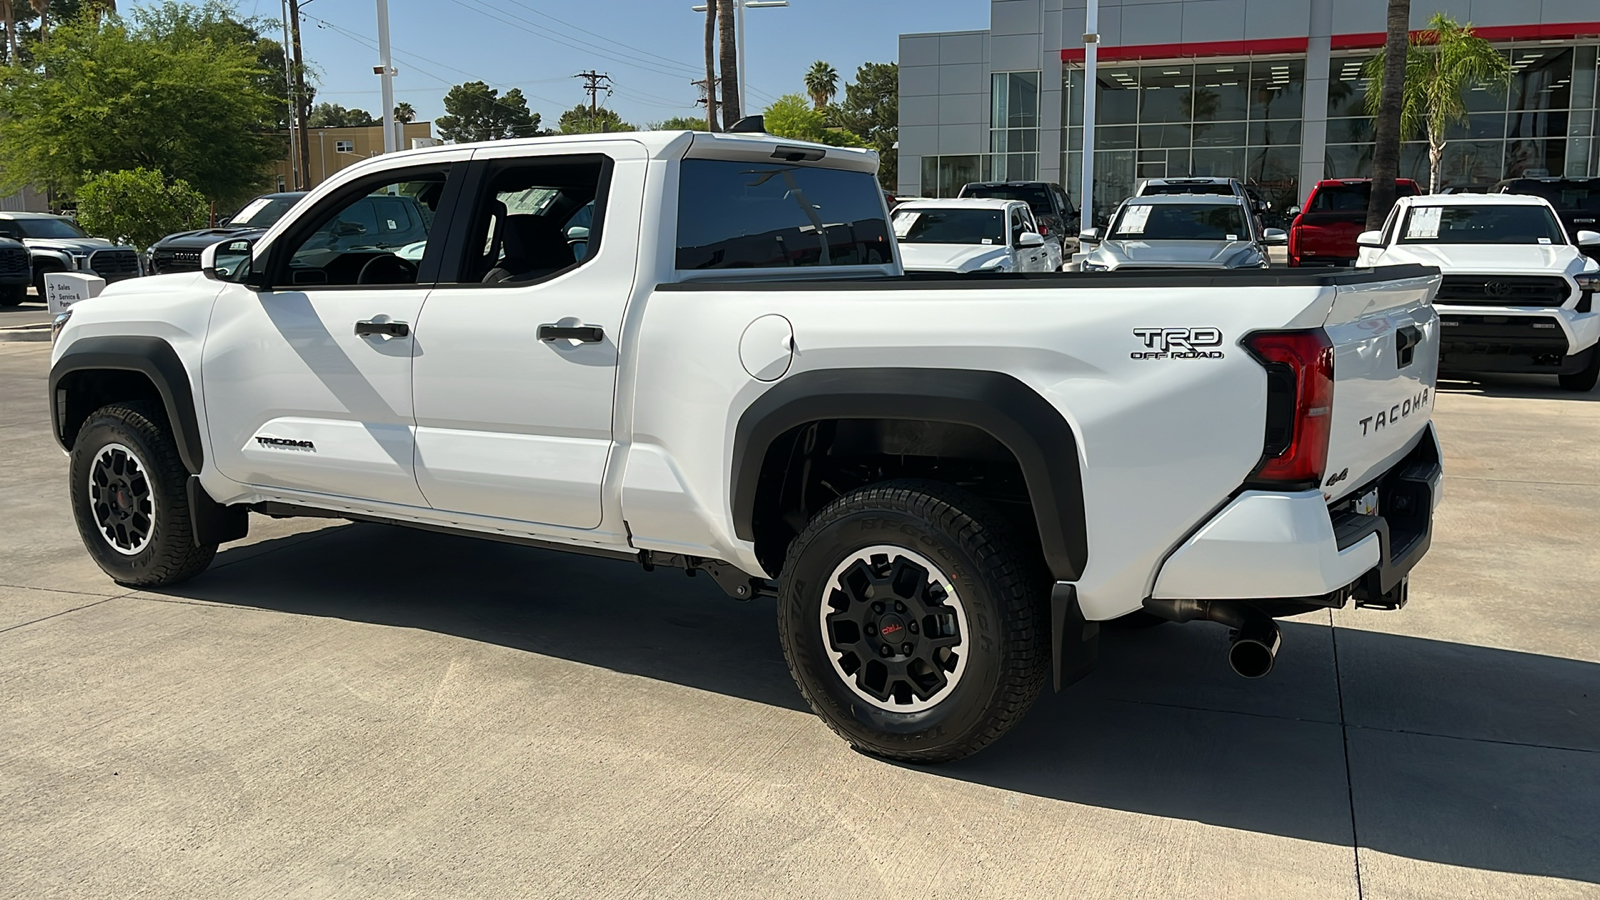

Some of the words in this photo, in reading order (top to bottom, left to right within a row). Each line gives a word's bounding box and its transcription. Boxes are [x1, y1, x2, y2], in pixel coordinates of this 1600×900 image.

[175, 252, 200, 260] TOYOT
[1132, 327, 1224, 352] TRD
[1130, 351, 1168, 360] OFF
[1170, 351, 1225, 360] ROAD
[1359, 387, 1429, 437] TACOMA
[254, 436, 315, 449] TACOMA
